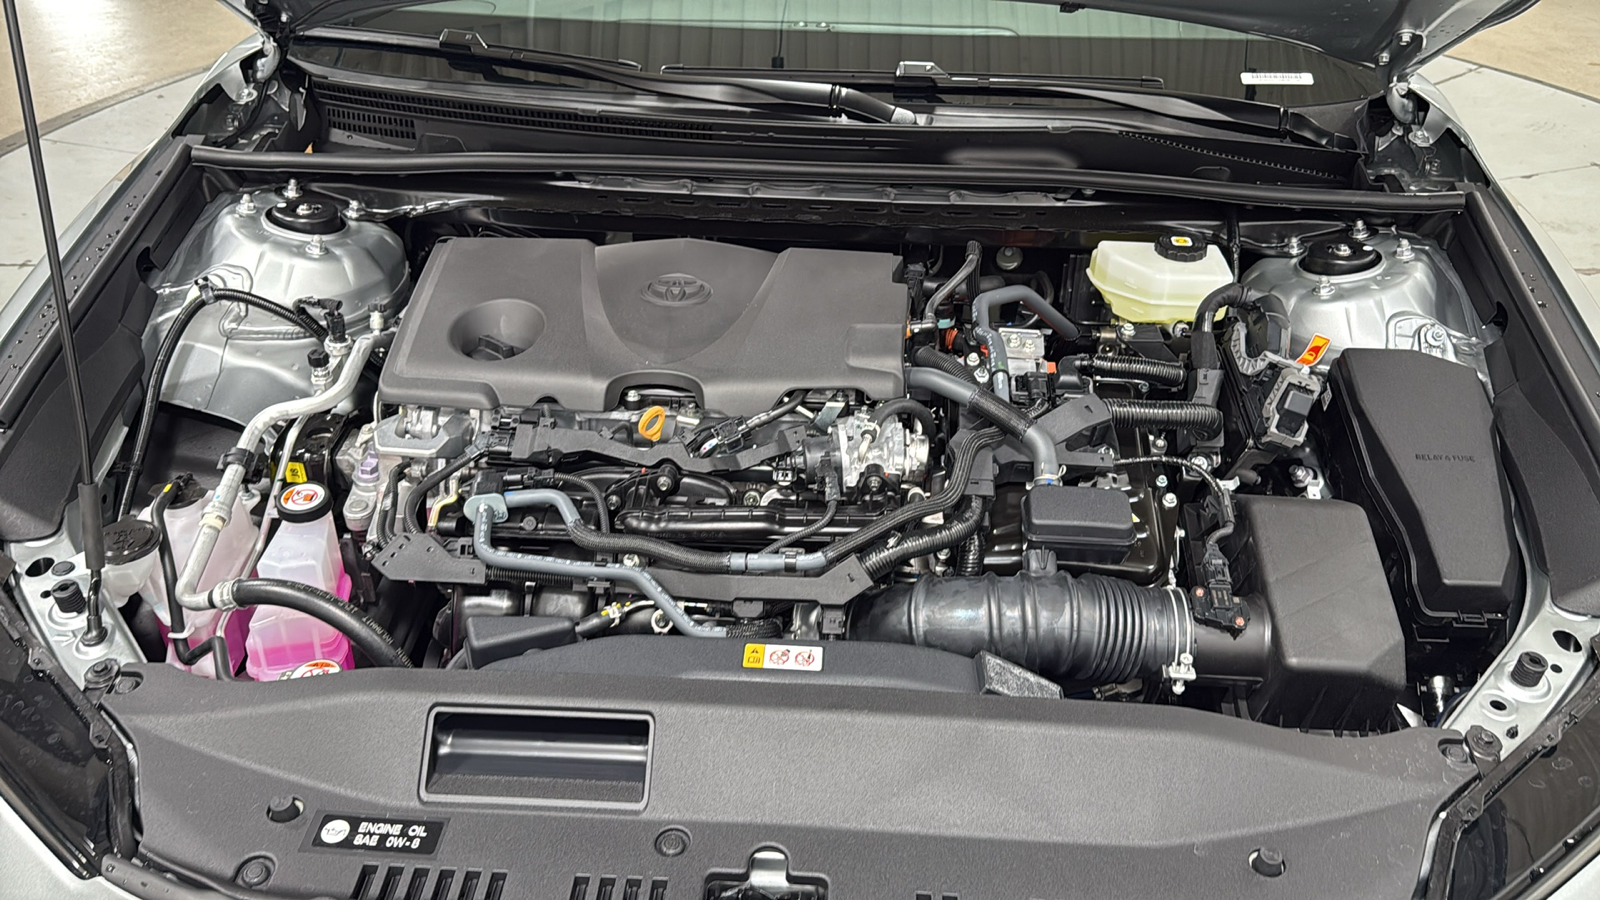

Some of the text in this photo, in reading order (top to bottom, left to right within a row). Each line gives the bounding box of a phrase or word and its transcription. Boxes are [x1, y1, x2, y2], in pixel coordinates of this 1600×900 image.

[1414, 453, 1443, 461] RELAY
[1452, 455, 1476, 463] FUSE
[358, 822, 428, 838] ENGINE OIL
[353, 834, 380, 847] SAE
